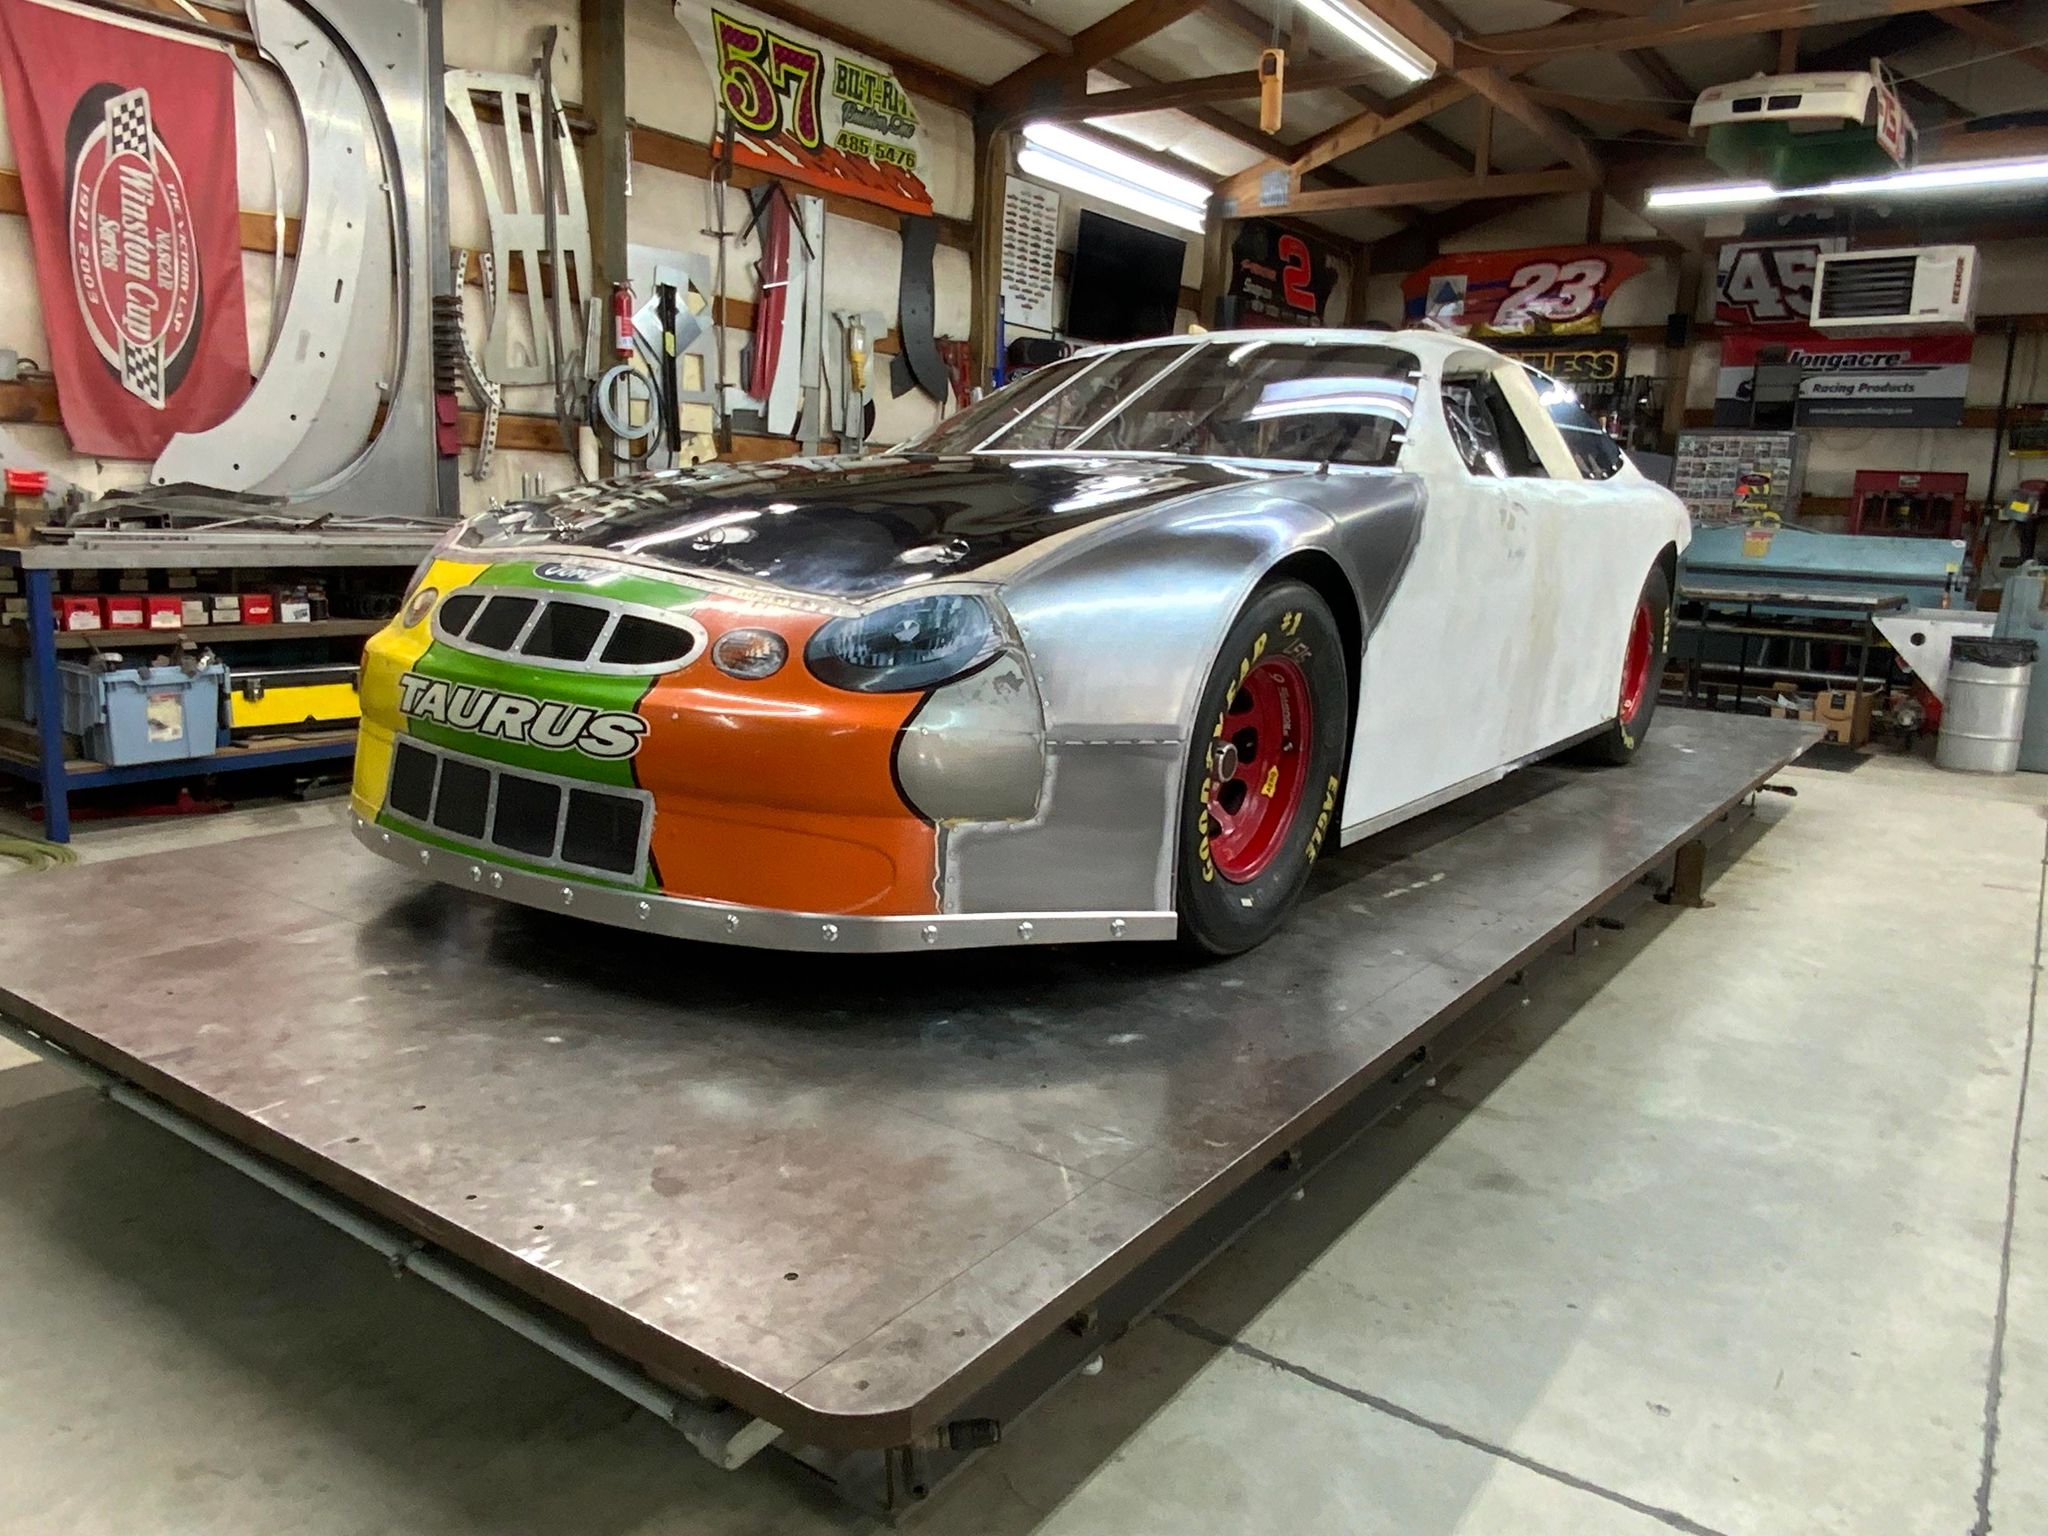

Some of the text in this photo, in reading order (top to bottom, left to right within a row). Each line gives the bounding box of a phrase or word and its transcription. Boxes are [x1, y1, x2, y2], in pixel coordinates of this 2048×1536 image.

[711, 9, 824, 154] 57
[98, 213, 121, 272] Series
[119, 165, 159, 341] Winston Cup
[155, 227, 174, 291] NASCAR
[167, 183, 190, 332] THE VICTORY LAP
[1278, 234, 1316, 313] 2
[1493, 258, 1609, 325] 23
[1723, 246, 1817, 321] 45
[1812, 382, 1915, 396] Racing Products
[399, 672, 650, 760] TAURUS
